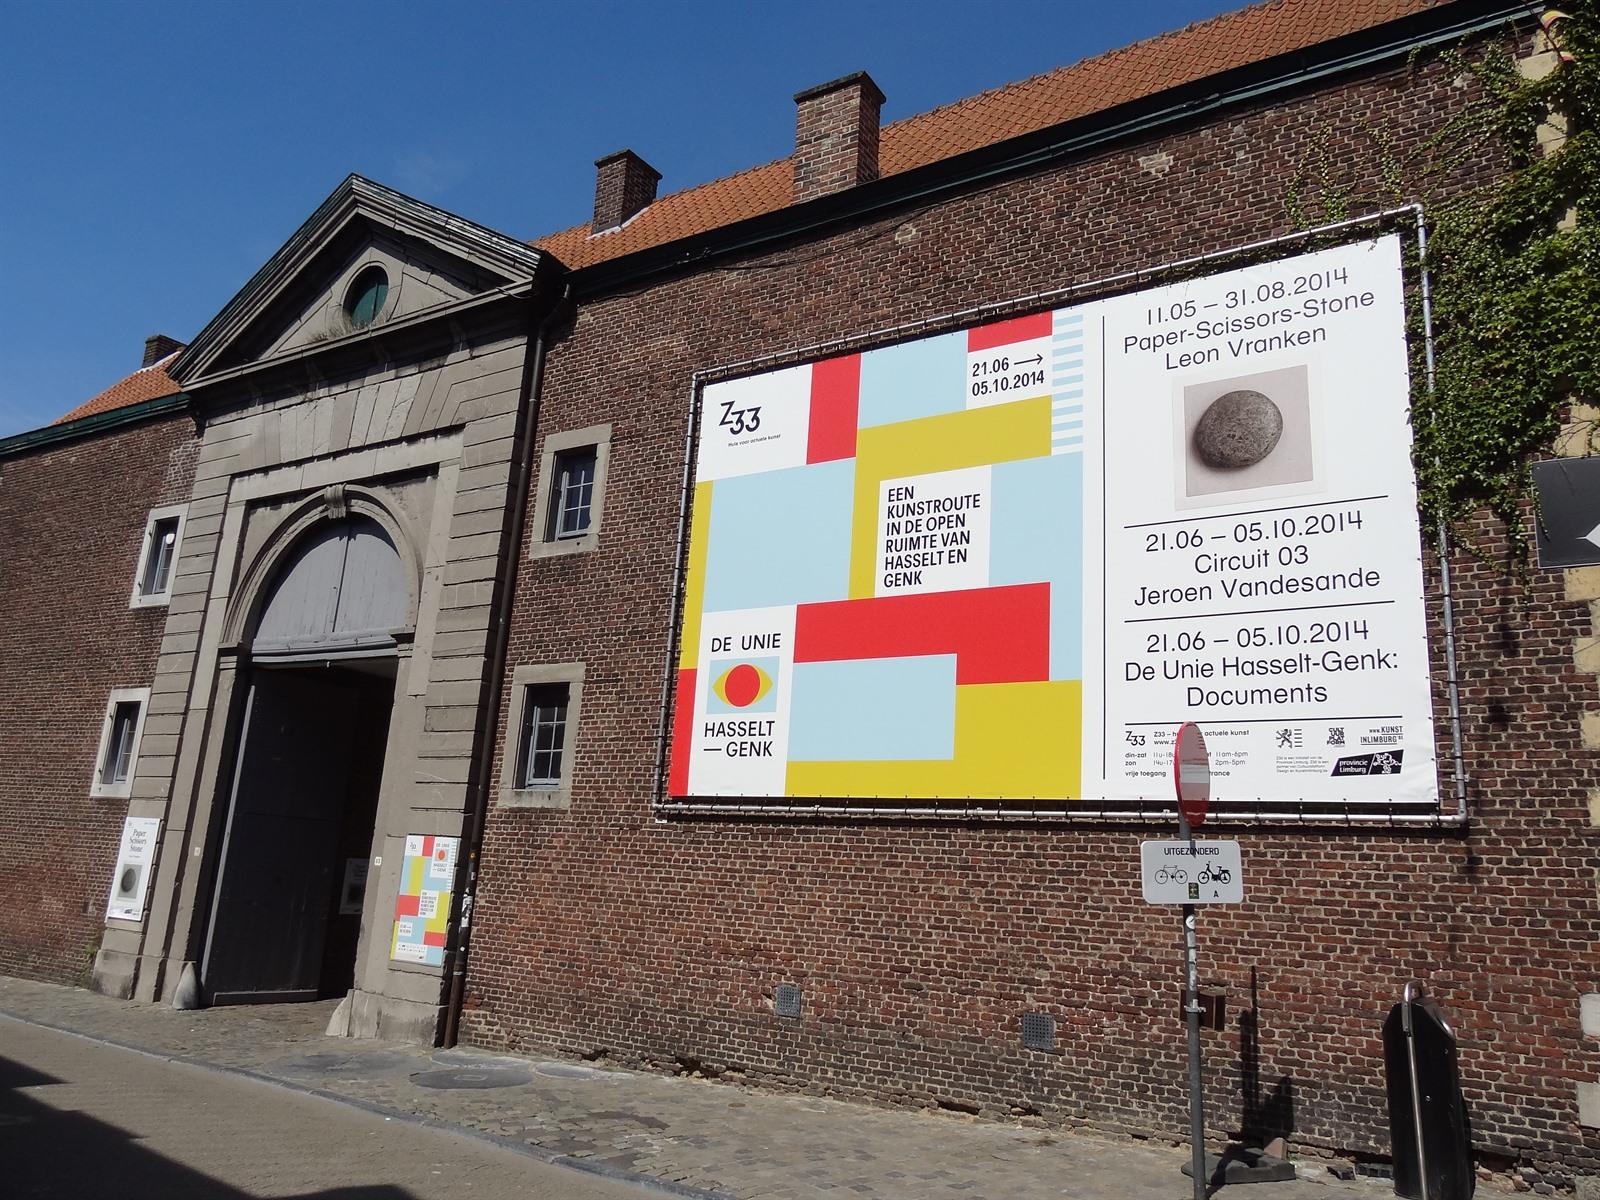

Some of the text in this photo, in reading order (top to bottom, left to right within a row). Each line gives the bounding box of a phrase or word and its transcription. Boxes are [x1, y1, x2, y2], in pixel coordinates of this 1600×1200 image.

[1147, 300, 1197, 325] 11.05
[1225, 267, 1348, 309] 31.08.2014
[1124, 291, 1375, 354] Paper-Scissors-Stone
[1166, 327, 1326, 370] Leon Vranken
[972, 357, 1009, 377] 21.06
[972, 370, 1044, 396] 05.10.2014
[719, 400, 761, 435] Z33
[888, 486, 914, 502] EEN
[887, 493, 981, 519] KUNSTROUTE
[886, 513, 966, 536] IN DE OPEN
[1146, 529, 1203, 552] 21.06
[1233, 510, 1363, 543] 05.10.2014
[886, 530, 970, 553] RUIMTE VAN
[885, 548, 967, 570] HASSELT EN
[1194, 545, 1309, 574] Circuit 03
[884, 570, 922, 588] GENK
[1134, 567, 1380, 606] Jeroen Vandesande
[711, 633, 781, 652] DE UNIE
[1147, 631, 1205, 652] 21.06
[1236, 619, 1369, 648] 05.10.2014
[1125, 649, 1398, 681] De Unie Hasselt-Genk:
[1187, 684, 1328, 707] Documents
[704, 720, 775, 737] HASSELT
[1125, 731, 1146, 746] Z33
[1163, 847, 1220, 855] UITGEZONDERD
[1213, 890, 1219, 898] A
